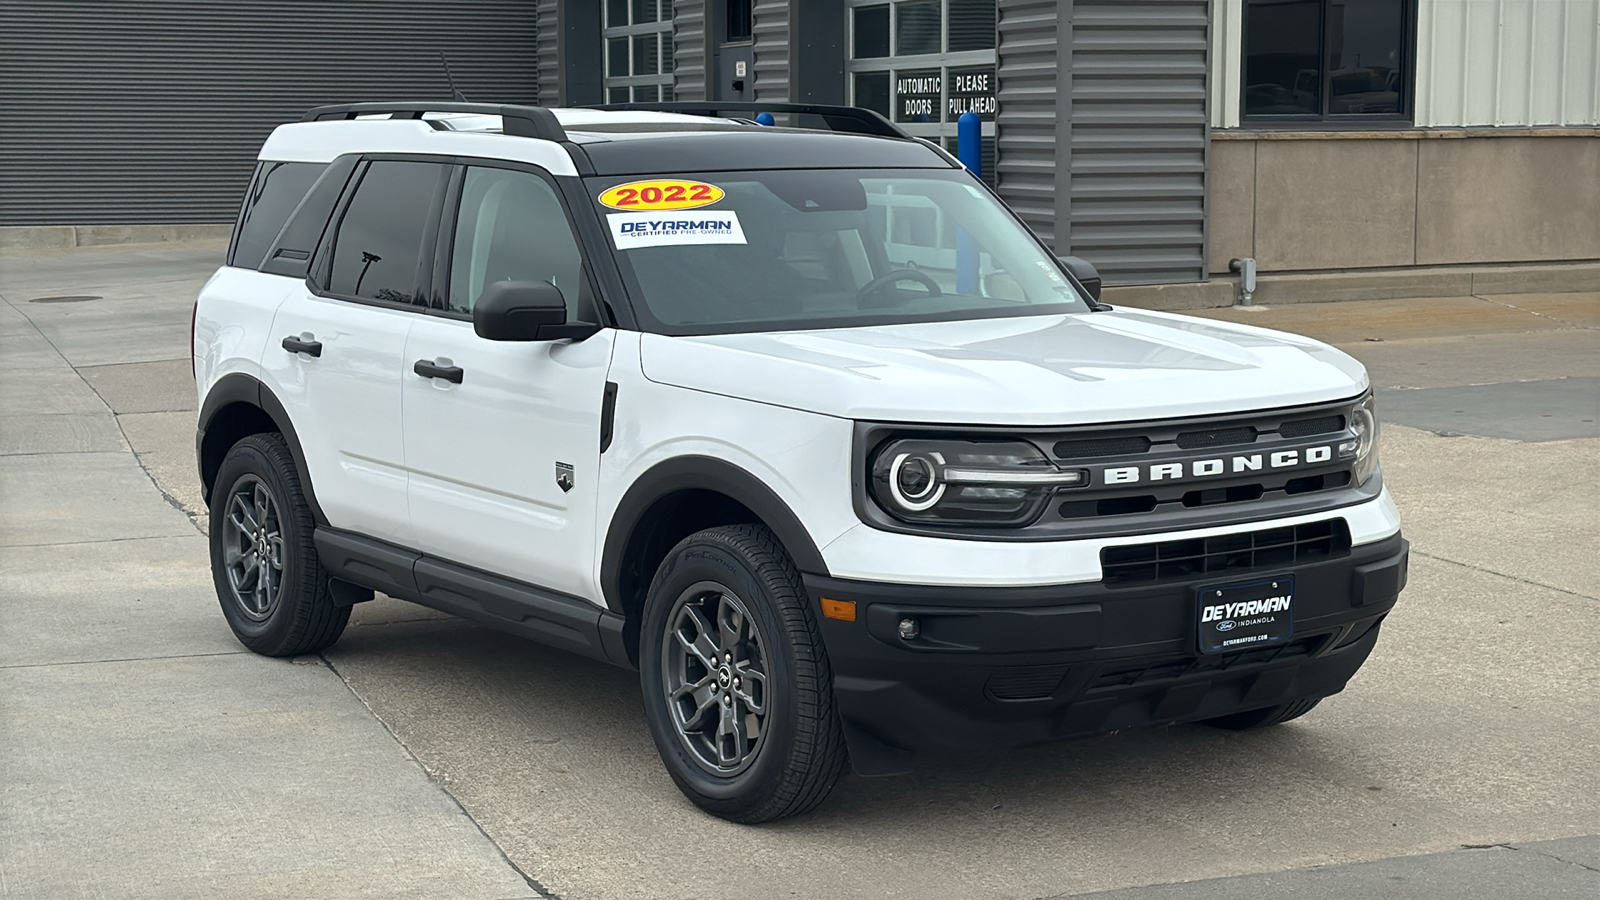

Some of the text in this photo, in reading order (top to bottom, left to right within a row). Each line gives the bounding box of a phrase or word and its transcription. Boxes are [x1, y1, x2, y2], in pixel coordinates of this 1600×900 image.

[897, 77, 940, 94] AUTOMATIC
[956, 74, 988, 92] PLEASE
[905, 99, 932, 115] DOORS
[949, 97, 996, 114] PULL AHEAD
[615, 184, 713, 207] 2022
[620, 220, 732, 234] DEYARMAN
[1104, 445, 1331, 485] BRONCO
[1201, 595, 1292, 623] DEYARMAN
[1238, 616, 1275, 627] INDIANOLA
